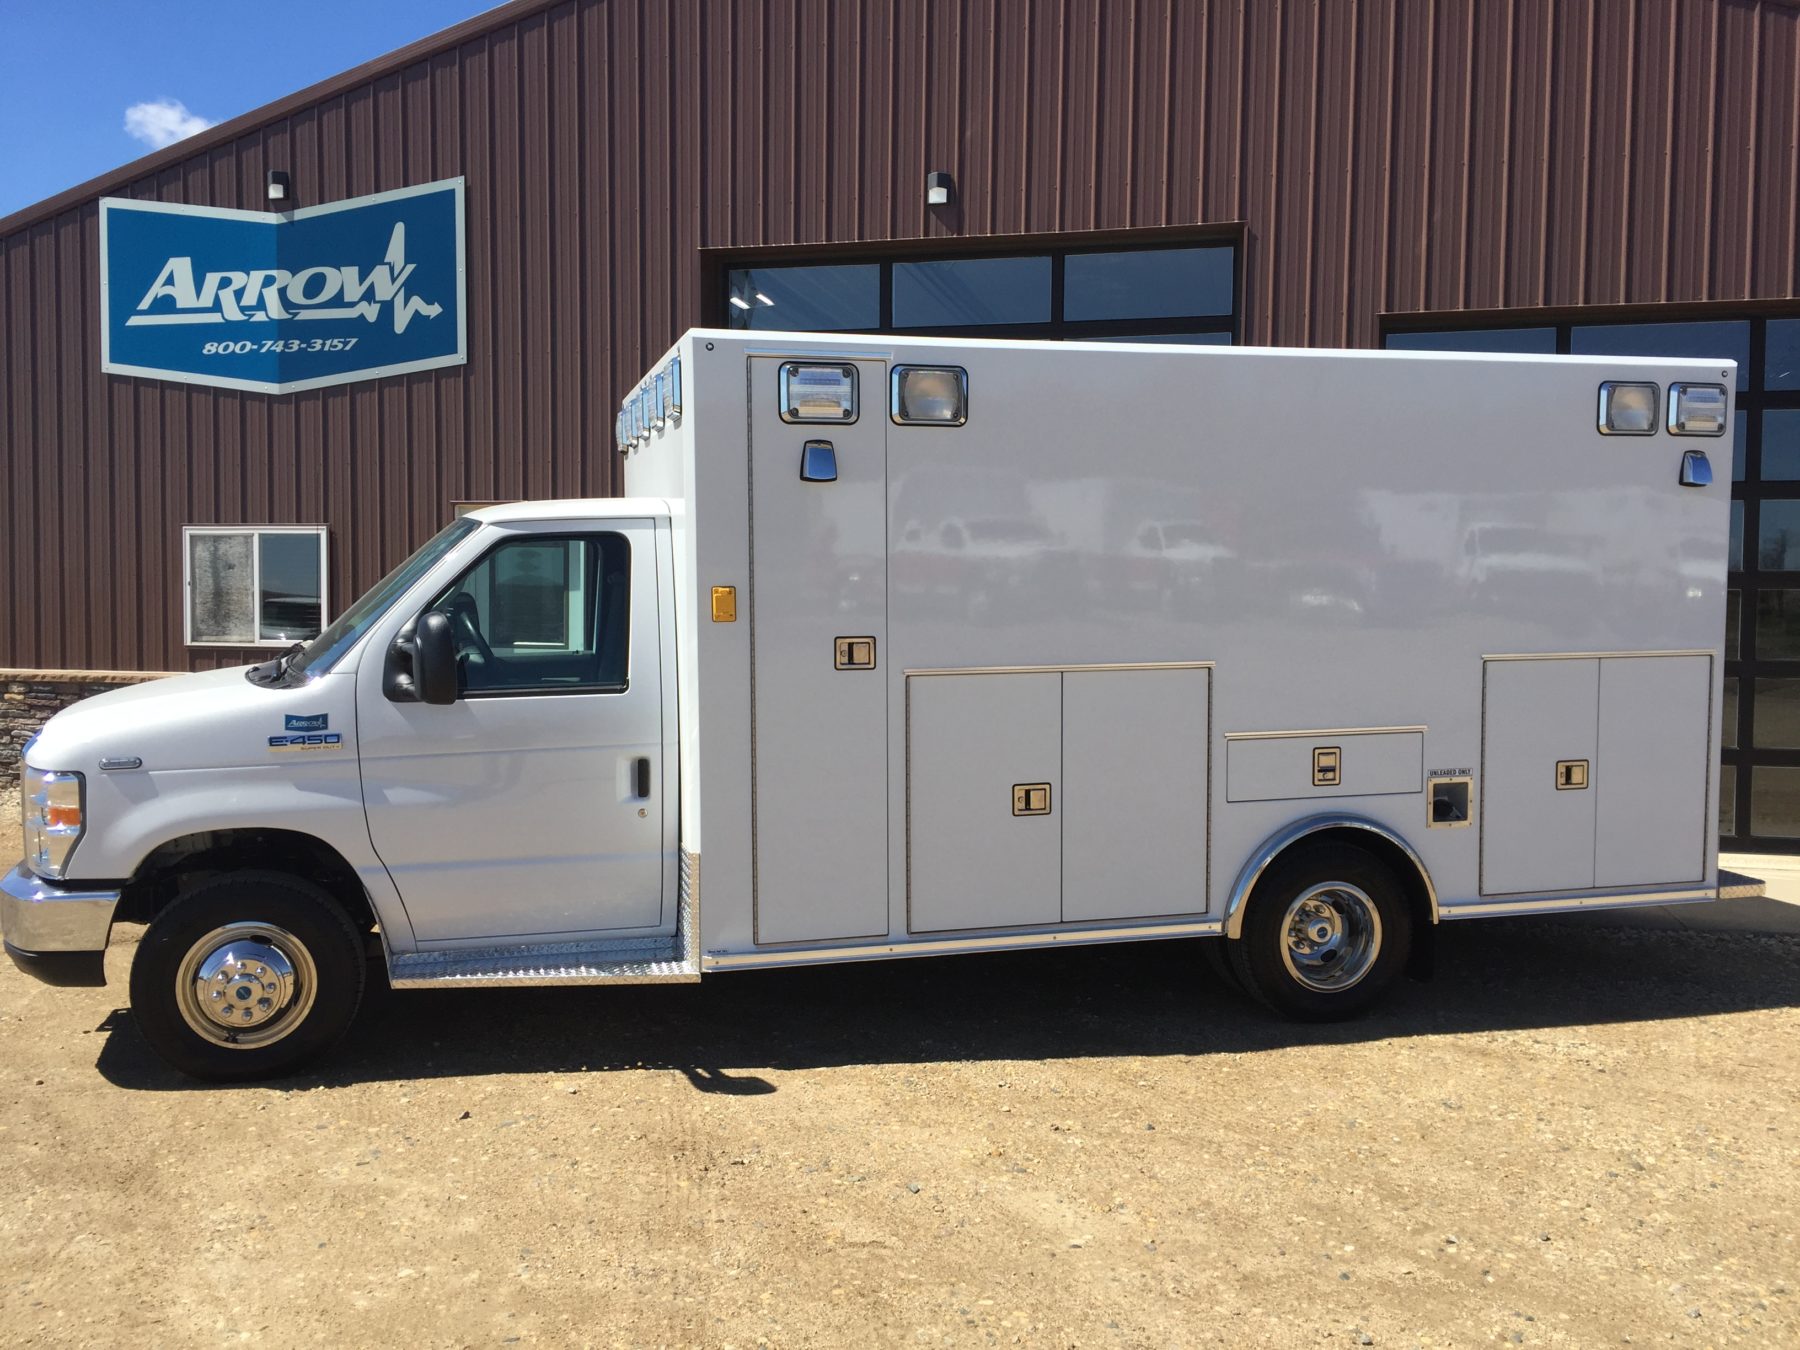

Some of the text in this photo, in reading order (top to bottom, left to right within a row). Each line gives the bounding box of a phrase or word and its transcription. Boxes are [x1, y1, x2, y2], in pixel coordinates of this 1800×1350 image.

[136, 256, 418, 321] ARROW
[202, 337, 359, 355] 800-743-3157
[1429, 768, 1471, 777] UNLEADED ONLY
